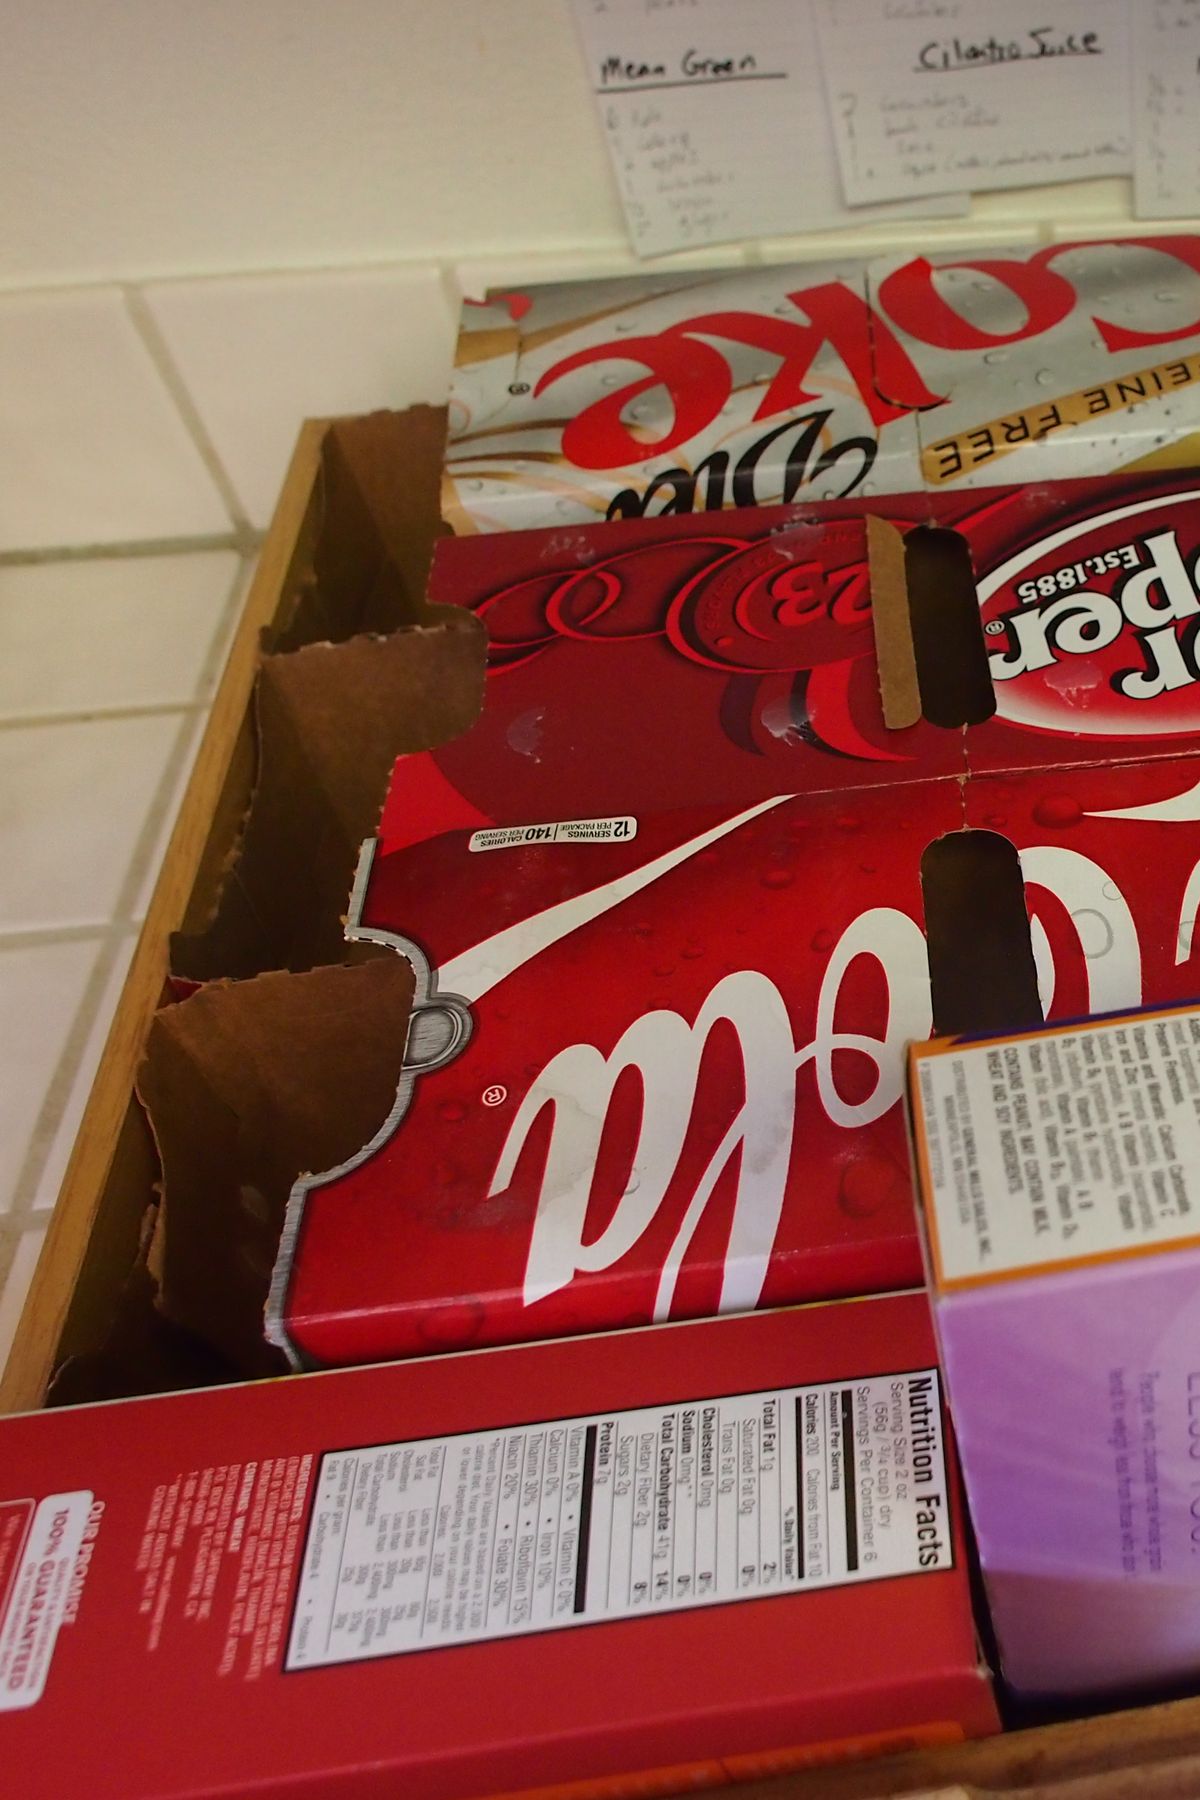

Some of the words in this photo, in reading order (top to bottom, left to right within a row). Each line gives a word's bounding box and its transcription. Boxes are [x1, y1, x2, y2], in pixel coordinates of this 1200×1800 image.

[601, 56, 666, 84] Mean
[682, 48, 757, 76] Green
[934, 404, 1063, 479] FREE
[1014, 540, 1143, 605] Est.1885
[770, 560, 873, 627] 23
[480, 835, 522, 847] CALORIES
[524, 825, 552, 841] 140
[559, 820, 595, 834] PACKAGE
[566, 826, 611, 841] SERVINGS
[595, 820, 612, 830] PER
[613, 819, 631, 838] 12
[762, 1398, 776, 1430] Total
[805, 1392, 819, 1435] Calories
[828, 1389, 840, 1429] Amount
[854, 1384, 872, 1446] Servings
[871, 1400, 889, 1434] (56g
[887, 1380, 906, 1434] Serving
[597, 1420, 614, 1466] Protein
[660, 1412, 675, 1444] Total
[680, 1408, 695, 1455] Sodium
[700, 1406, 715, 1477] Cholesterol
[721, 1421, 735, 1454] Trans
[762, 1431, 776, 1454] Fat
[829, 1430, 840, 1449] Per
[907, 1375, 939, 1485] Nutrition
[505, 1434, 522, 1470] Niacin
[525, 1431, 543, 1476] Thiamin
[546, 1428, 563, 1474] Calcium
[567, 1424, 584, 1469] Vitamin
[615, 1434, 633, 1478] Sugars
[635, 1431, 654, 1474] Dietary
[741, 1417, 755, 1474] Saturated
[805, 1435, 819, 1456] 200
[858, 1448, 873, 1473] Per
[893, 1436, 908, 1467] Size
[594, 1468, 610, 1485] 7g
[721, 1456, 735, 1475] Fat
[760, 1455, 776, 1472] 1g
[828, 1450, 842, 1492] Serving
[894, 1468, 909, 1479] 2
[614, 1478, 631, 1498] 2g
[636, 1475, 652, 1508] Fiber
[654, 1446, 673, 1532] Carbohydrate
[697, 1478, 713, 1508] 0mg
[719, 1477, 735, 1495] 0g
[741, 1476, 755, 1497] Fat
[806, 1467, 821, 1511] Calories
[876, 1467, 892, 1500] cup)
[895, 1481, 908, 1500] oz
[81, 1500, 106, 1545] OUR
[633, 1509, 651, 1528] 2g
[738, 1497, 755, 1516] 0g
[860, 1475, 877, 1547] Container
[878, 1503, 893, 1529] dry
[42, 1506, 70, 1557] 100%
[807, 1512, 821, 1540] from
[914, 1492, 945, 1568] Facts
[494, 1537, 512, 1575] Folate
[538, 1531, 555, 1558] Iron
[559, 1527, 576, 1575] Vitamin
[652, 1533, 670, 1560] 41g
[807, 1541, 822, 1562] Fat
[863, 1550, 877, 1562] 6
[514, 1534, 534, 1593] Riboflavin
[762, 1560, 777, 1584] 2%
[61, 1541, 96, 1626] PROMISE
[654, 1569, 669, 1601] 14%
[7, 1558, 57, 1692] GUARANTEED
